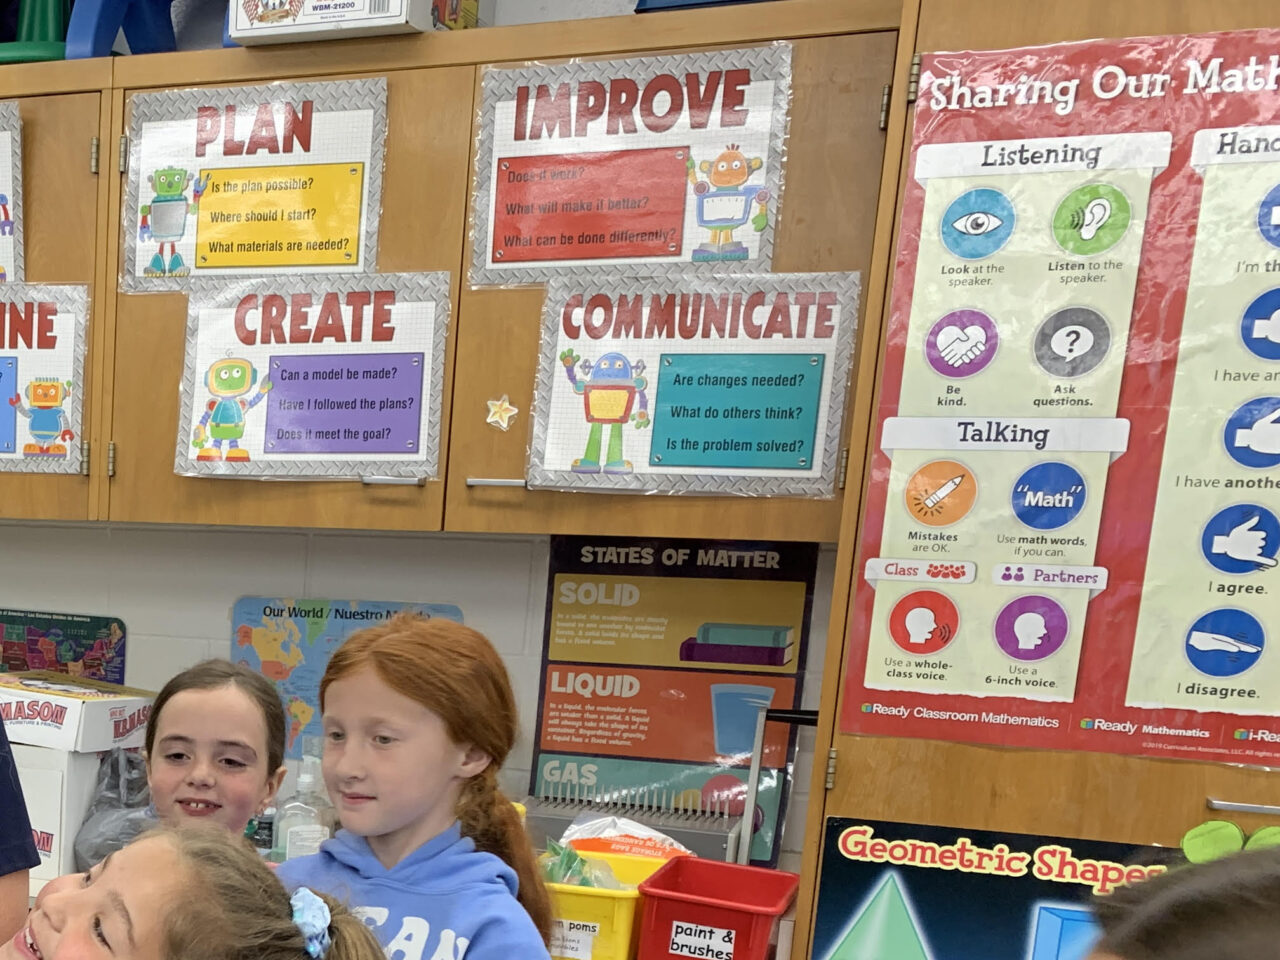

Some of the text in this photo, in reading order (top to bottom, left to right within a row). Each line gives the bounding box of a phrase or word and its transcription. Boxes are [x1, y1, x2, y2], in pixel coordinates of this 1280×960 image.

[312, 1, 355, 12] WBM-21200
[930, 76, 1081, 116] Sharing
[1092, 65, 1171, 100] Our
[513, 69, 750, 142] IMPROVE
[195, 100, 313, 158] PLAN
[981, 143, 1102, 169] Listening
[211, 177, 314, 194] Is the plan possible?
[504, 228, 676, 248] What can be done differently?
[209, 238, 350, 254] What materials are needed?
[941, 264, 1005, 275] Look at the
[948, 277, 994, 288] speaker.
[234, 290, 396, 346] CREATE
[562, 291, 838, 340] COMMUNICATE
[280, 366, 398, 381] Can a model be made?
[673, 373, 805, 390] Are changes needed?
[946, 384, 961, 396] Be
[1054, 384, 1077, 395] Ask
[937, 396, 967, 407] kind.
[1033, 396, 1094, 408] questions.
[276, 427, 392, 441] Does it meet the goal?
[957, 421, 1050, 450] Talking
[667, 438, 804, 454] Is the problem solved?
[1184, 475, 1220, 488] have
[1224, 477, 1280, 489] anothe
[908, 531, 958, 542] Mistakes
[996, 535, 1088, 547] Use math words,
[912, 544, 951, 553] are OK.
[1014, 547, 1066, 558] if you can.
[580, 546, 780, 569] STATES OF MATTER
[884, 563, 919, 576] Class
[1033, 569, 1099, 584] Partners
[559, 581, 640, 607] SOLID
[1217, 584, 1268, 596] agree.
[263, 606, 285, 617] Our
[287, 607, 324, 619] World
[334, 608, 383, 620] Nuestro
[885, 658, 903, 666] Use
[914, 659, 953, 670] whole-
[887, 669, 948, 681] class voice.
[551, 672, 640, 698] LIQUID
[1185, 683, 1260, 699] disagree.
[872, 703, 1059, 728] Ready Classroom Mathematics
[1093, 717, 1210, 739] Ready Mathematics
[542, 760, 598, 786] GAS
[838, 825, 1031, 877] Geometric
[569, 922, 597, 932] poms
[675, 923, 733, 944] paint &
